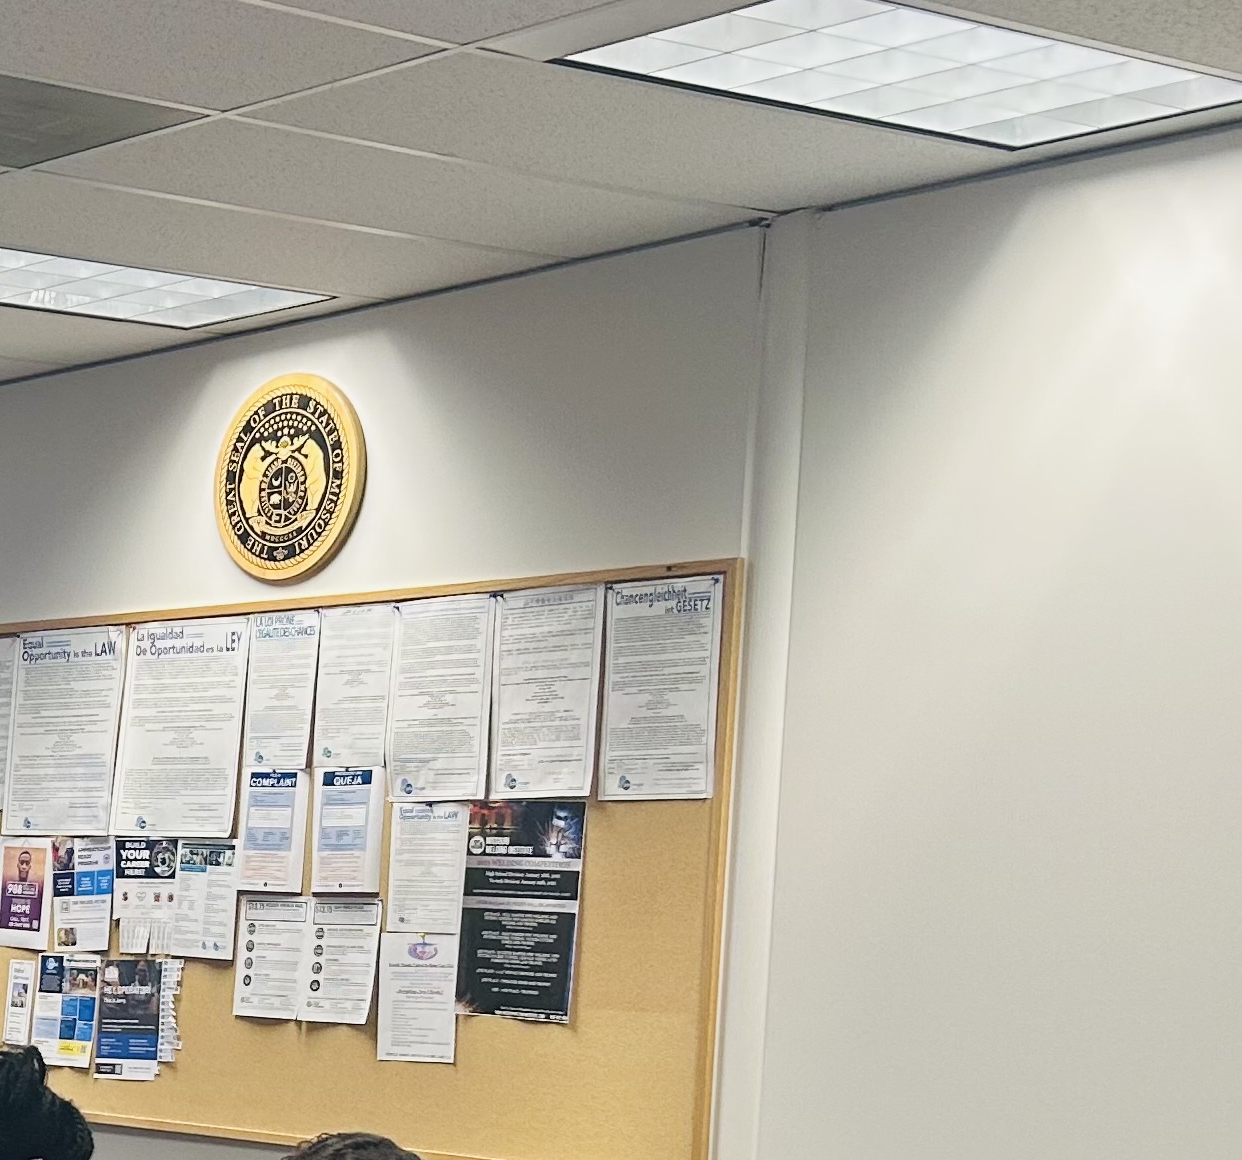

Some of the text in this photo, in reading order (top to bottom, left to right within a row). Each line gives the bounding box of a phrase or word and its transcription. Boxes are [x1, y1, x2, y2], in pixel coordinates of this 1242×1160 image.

[226, 394, 344, 559] THE GREAT SEAL OF THE STATE OF MISSOURI
[615, 585, 687, 607] Chancengleichheit
[675, 599, 711, 613] GESETZ
[136, 628, 184, 645] La Igualdad
[22, 637, 44, 651] Equal
[135, 644, 147, 656] De
[149, 640, 205, 659] Oportunidad
[205, 645, 215, 653] es
[216, 643, 224, 653] la
[225, 631, 242, 652] LEY
[22, 648, 71, 663] Opportunity
[81, 649, 92, 658] the
[94, 641, 116, 657] LAW
[250, 777, 296, 787] COMPLAINT
[333, 776, 363, 786] QUEJA
[120, 849, 150, 860] YOUR
[7, 883, 23, 894] 988
[10, 904, 30, 914] HOPE
